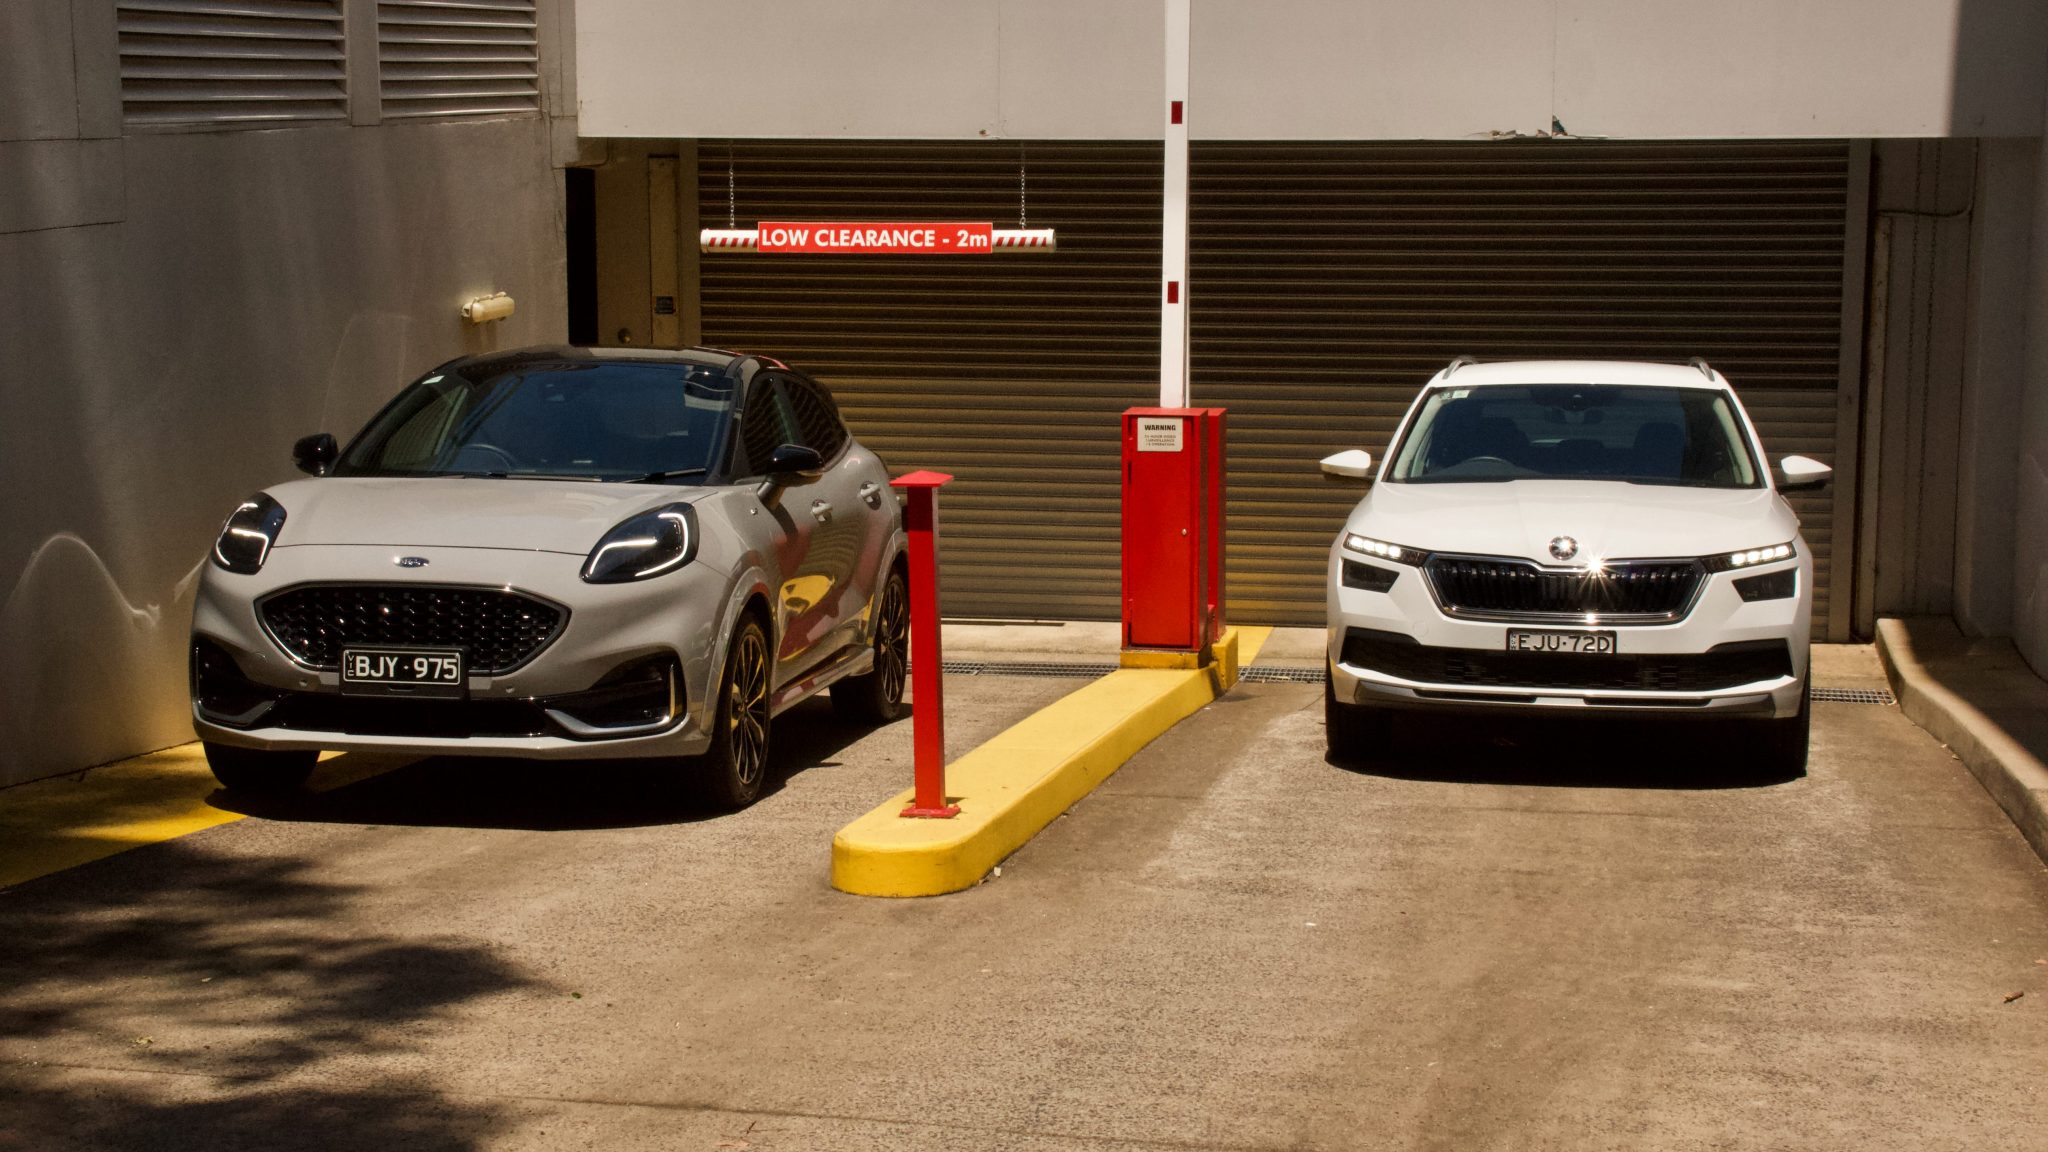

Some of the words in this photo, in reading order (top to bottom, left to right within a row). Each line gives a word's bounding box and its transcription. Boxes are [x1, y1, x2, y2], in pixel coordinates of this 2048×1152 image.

[761, 229, 809, 247] LOW
[814, 229, 935, 247] CLEARANCE
[956, 230, 988, 247] 2m
[347, 655, 355, 676] VIC
